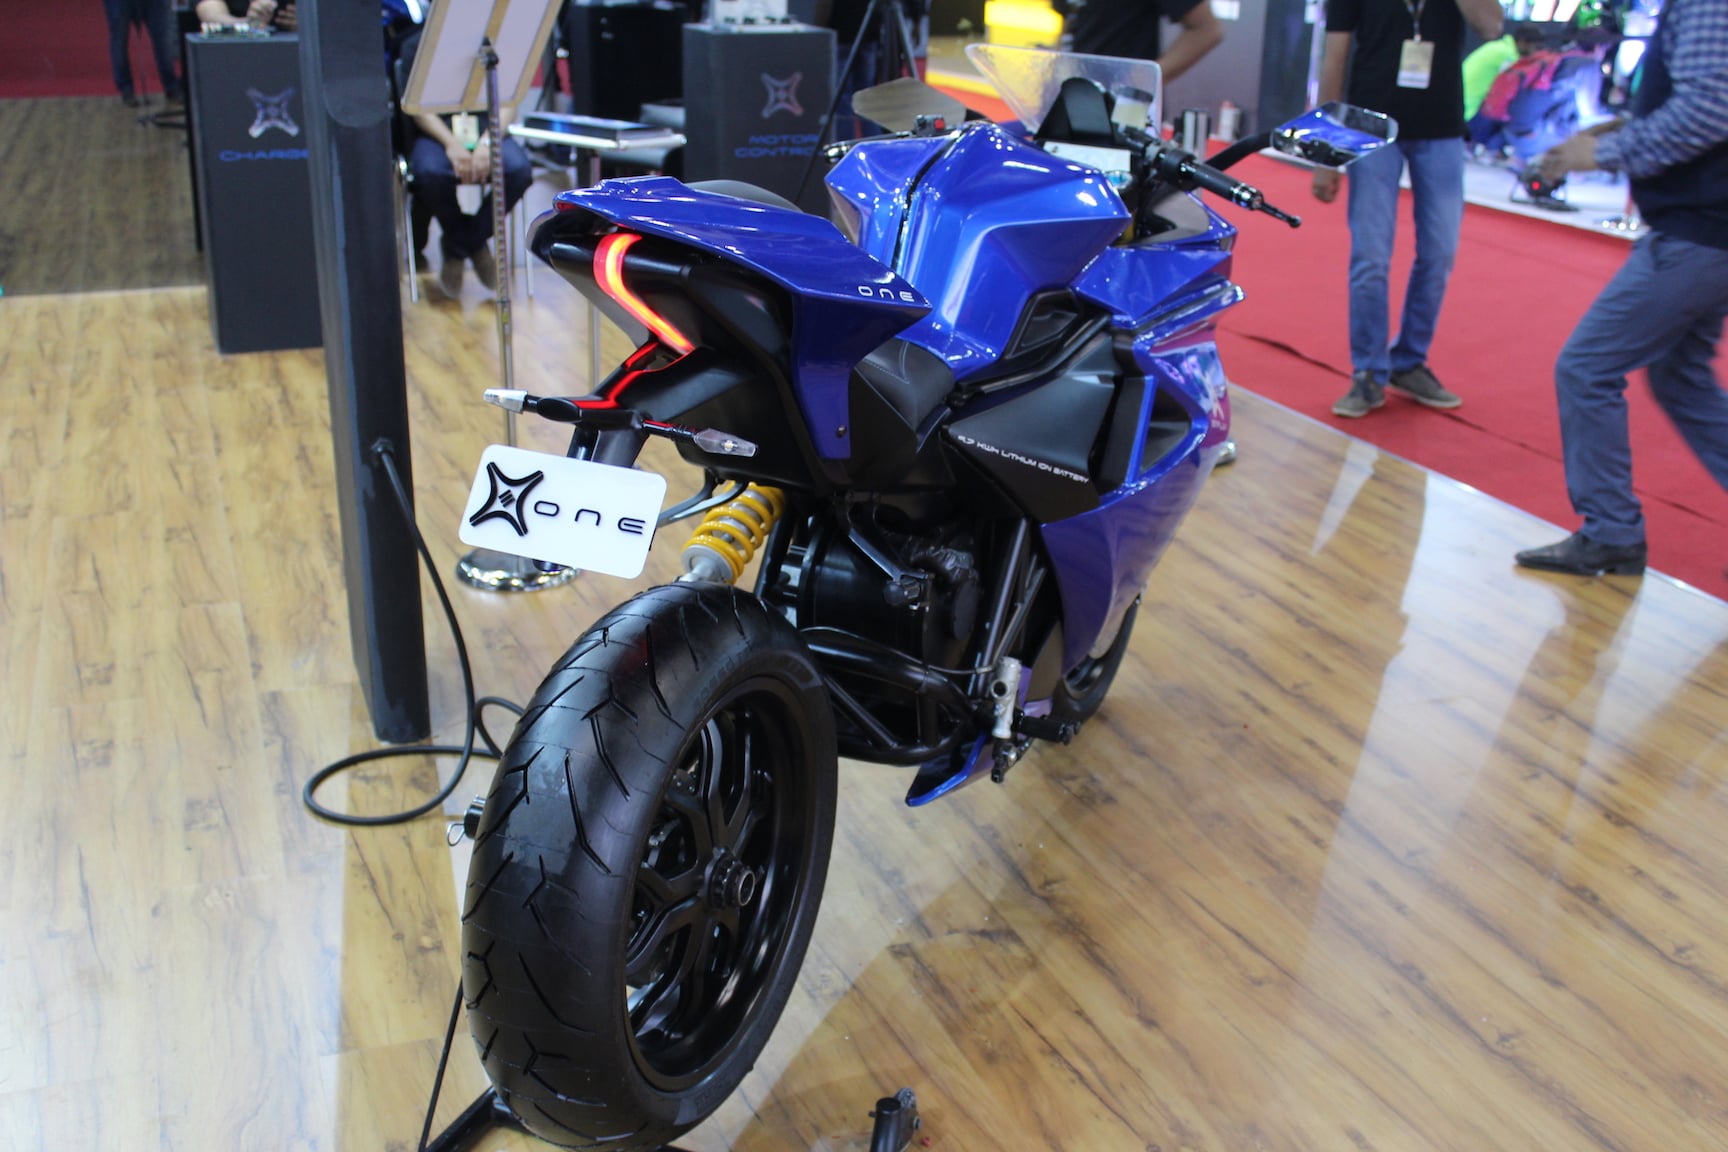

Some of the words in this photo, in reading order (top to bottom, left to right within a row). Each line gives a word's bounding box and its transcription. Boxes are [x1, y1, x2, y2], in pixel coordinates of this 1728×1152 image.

[735, 147, 824, 157] CONTRO
[858, 286, 915, 302] ONE
[1001, 449, 1036, 466] LITHIUM
[1038, 462, 1052, 472] ION
[1053, 467, 1089, 482] BATTERY
